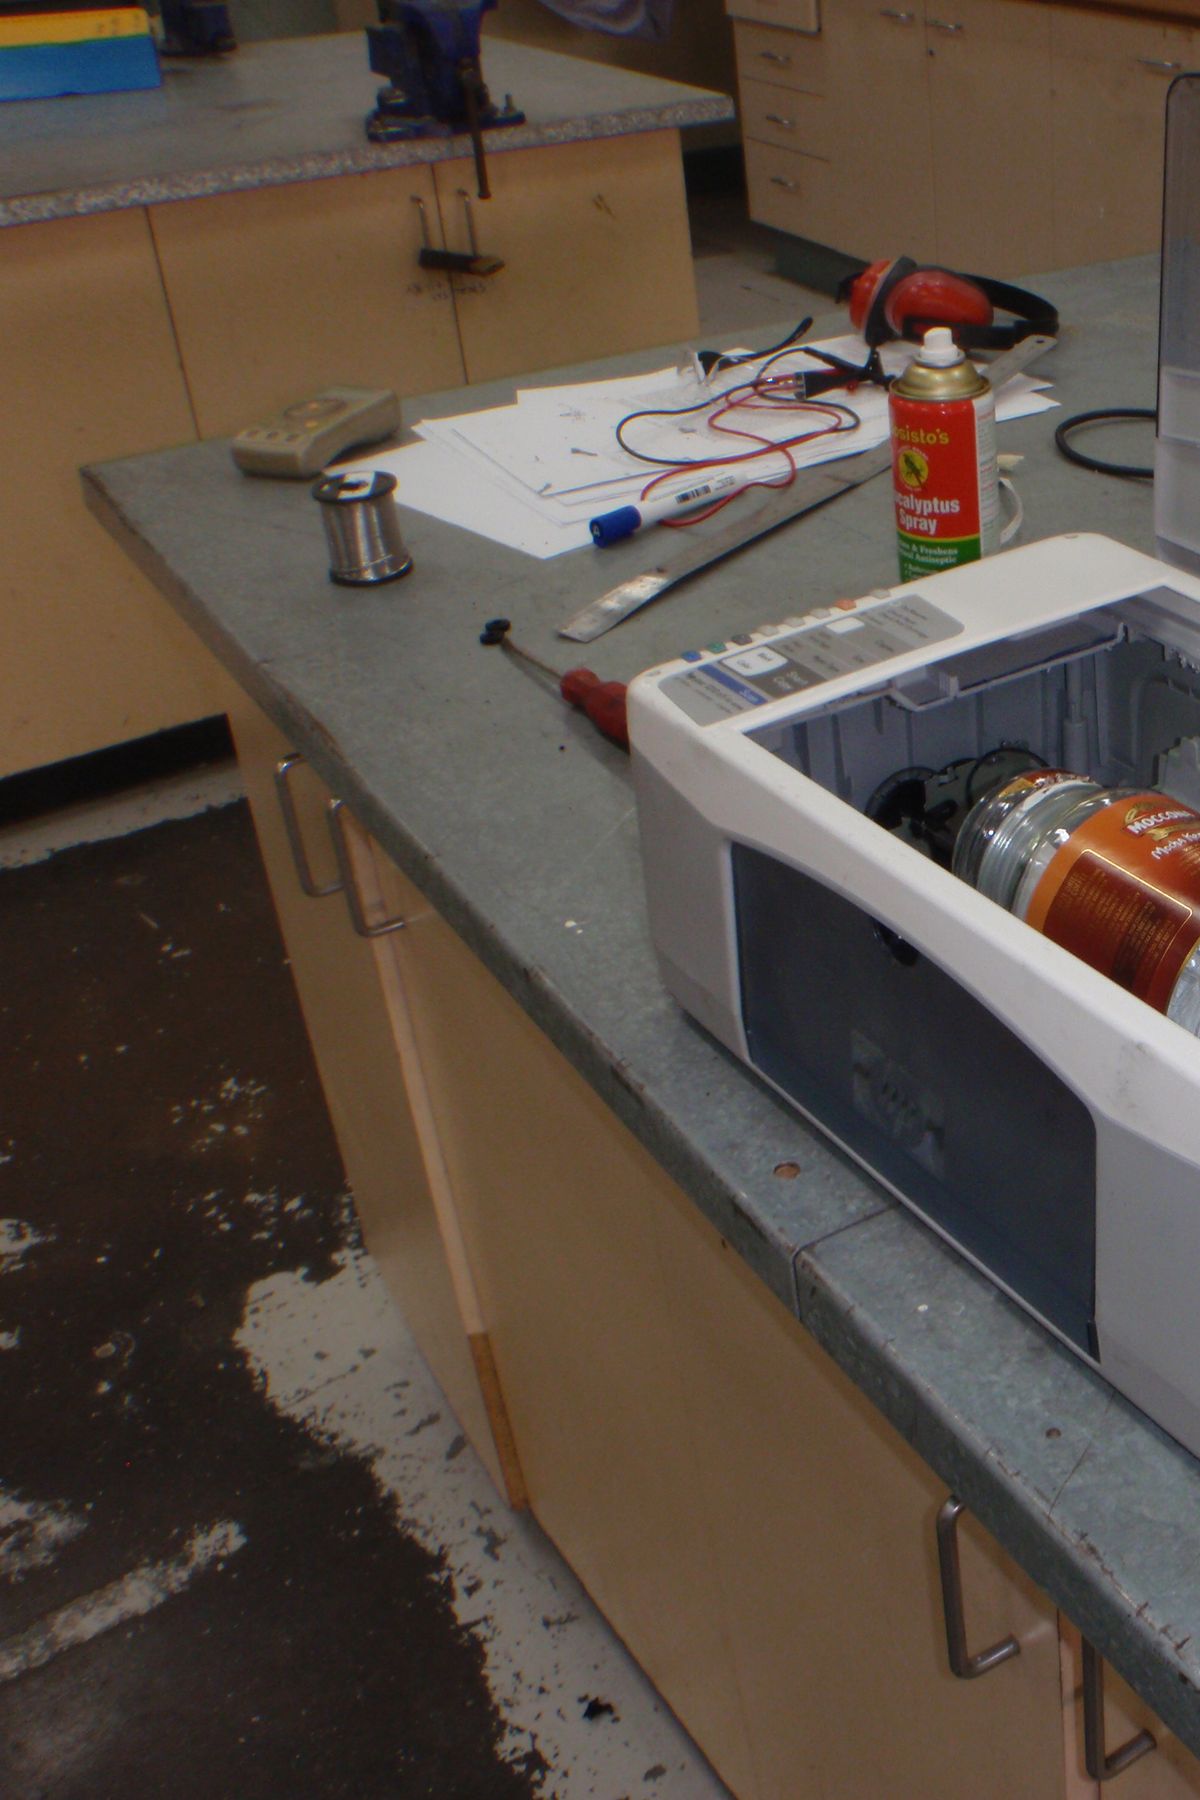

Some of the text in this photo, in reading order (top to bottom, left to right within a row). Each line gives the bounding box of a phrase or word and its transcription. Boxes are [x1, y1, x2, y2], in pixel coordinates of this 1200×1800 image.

[893, 424, 949, 445] osisto's
[895, 493, 960, 516] calyptus
[899, 508, 937, 536] Spray
